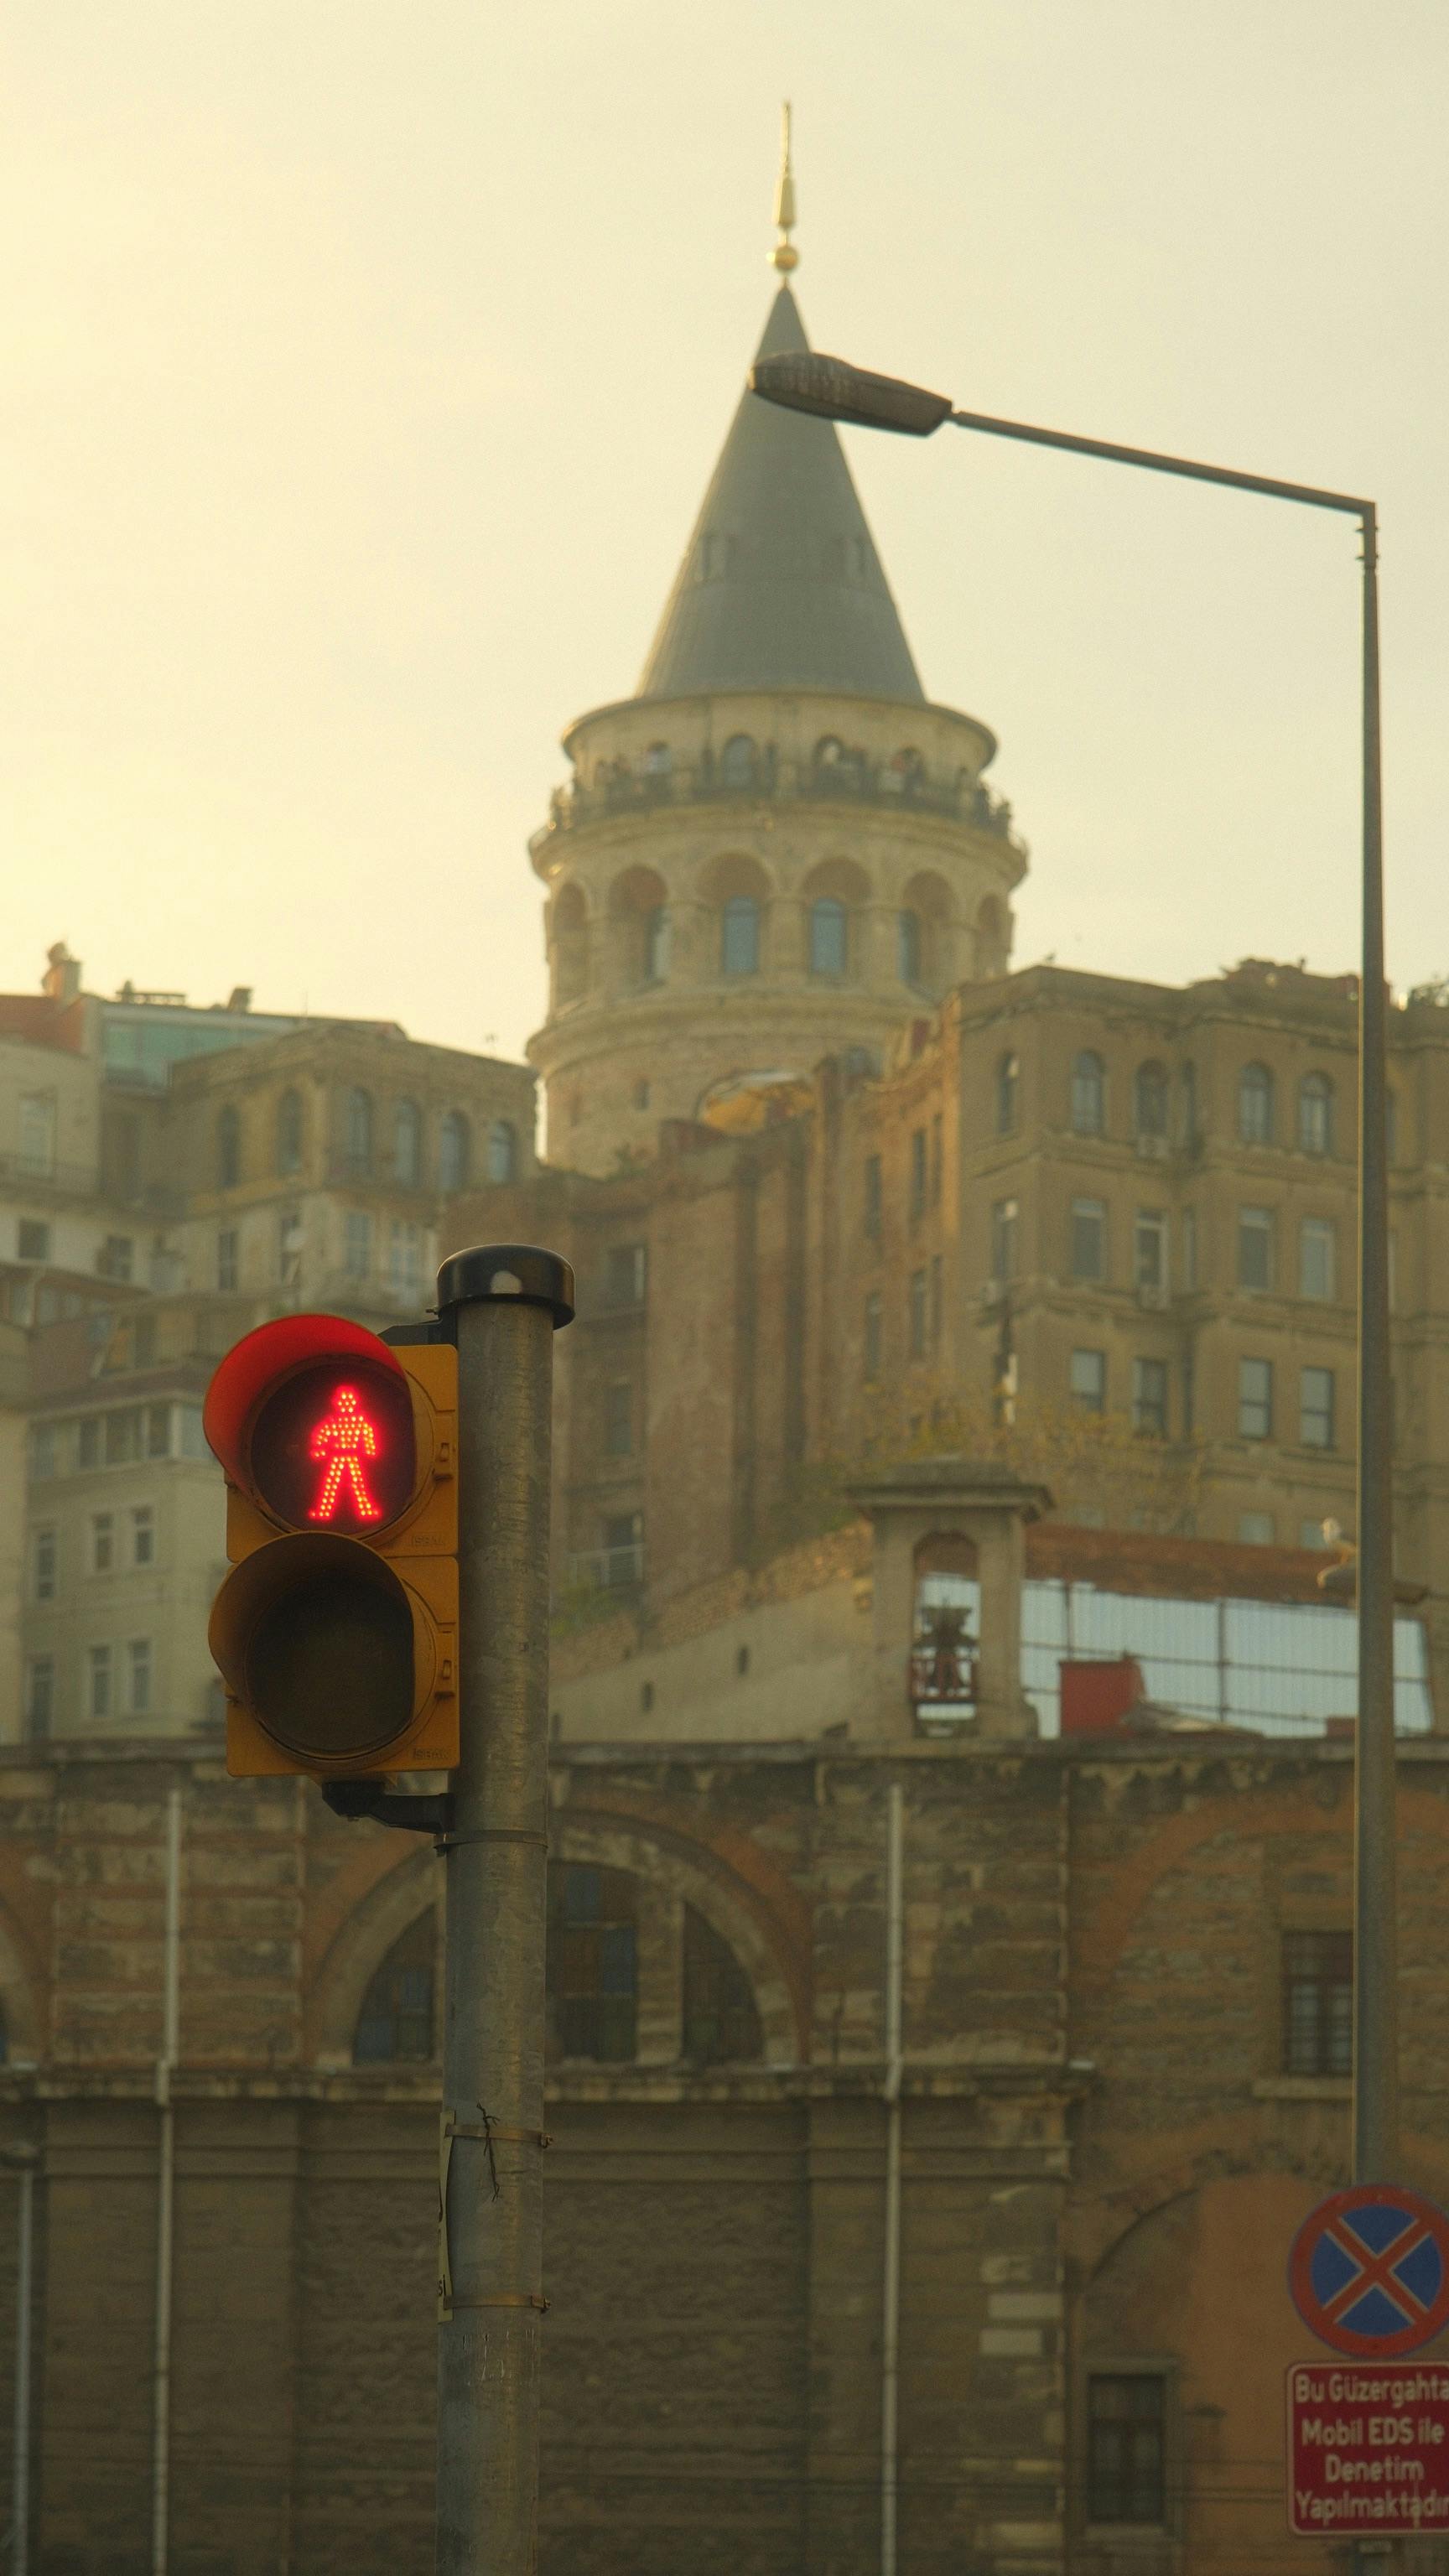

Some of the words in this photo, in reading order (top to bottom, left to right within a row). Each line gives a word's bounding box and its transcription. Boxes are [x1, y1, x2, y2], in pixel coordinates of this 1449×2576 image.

[1296, 2374, 1325, 2403] Bu
[1328, 2372, 1449, 2408] Güzergahta
[1301, 2418, 1363, 2446] Mobil
[1368, 2417, 1415, 2446] EDS
[1418, 2416, 1446, 2444] ile
[1325, 2454, 1425, 2483] Denetim
